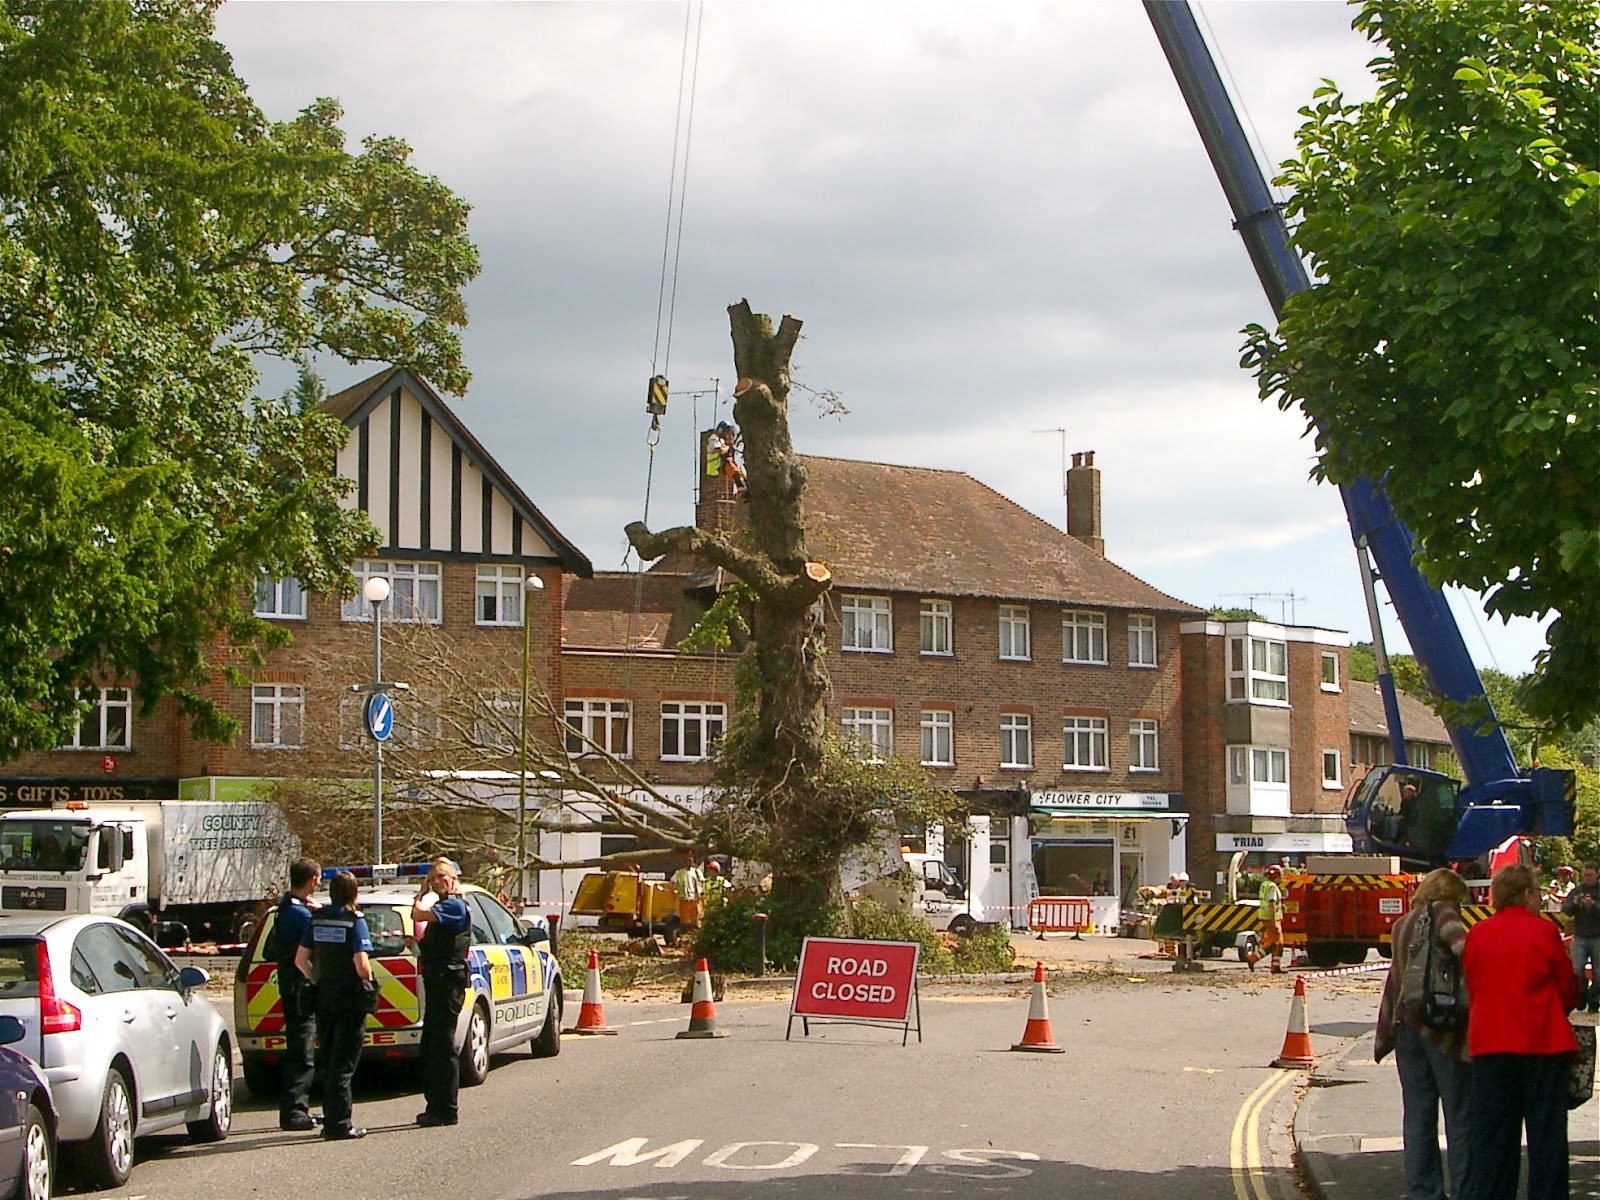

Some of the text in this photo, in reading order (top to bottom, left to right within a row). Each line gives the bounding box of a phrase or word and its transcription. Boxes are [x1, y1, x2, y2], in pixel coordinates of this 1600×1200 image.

[17, 786, 70, 801] GIFTS
[80, 786, 124, 801] TOYS
[1045, 793, 1121, 805] FLOWER CITY
[203, 815, 261, 831] COUNTY
[189, 836, 276, 850] TREE SURGEON
[1232, 837, 1264, 847] TRIAD
[374, 868, 395, 876] POLICE
[827, 957, 888, 976] ROAD
[811, 982, 896, 1003] CLOSED
[495, 1001, 542, 1024] POLICE
[569, 1137, 1040, 1178] SLOW
